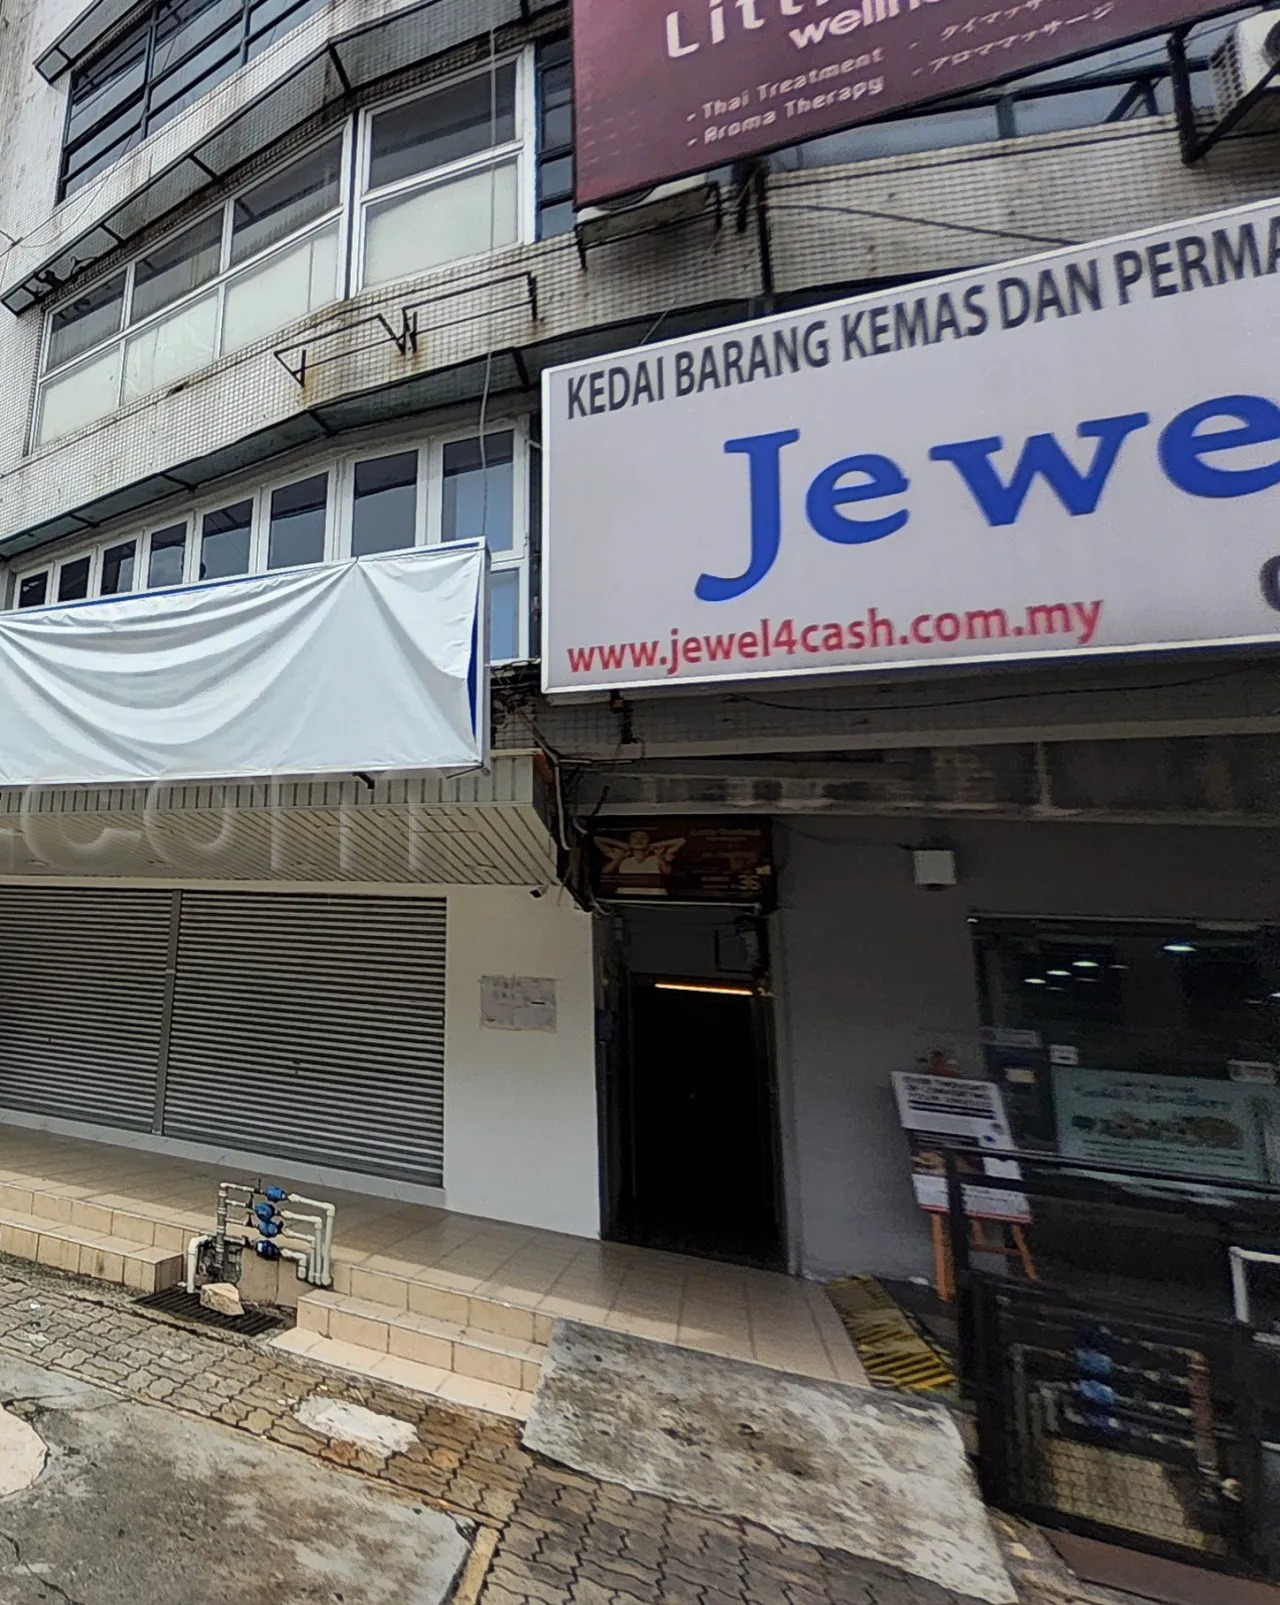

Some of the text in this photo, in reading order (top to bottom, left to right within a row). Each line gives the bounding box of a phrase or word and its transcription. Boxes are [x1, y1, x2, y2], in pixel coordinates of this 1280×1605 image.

[702, 47, 885, 119] Thai Treatment
[704, 75, 885, 144] Aroma Therapy
[567, 356, 665, 420] KEDAI
[674, 320, 830, 398] BARANG
[841, 284, 989, 361] KEMAS
[998, 258, 1103, 329] DAN
[694, 395, 1280, 602] Jewe
[567, 600, 1104, 675] www.jewel4cash.com.my
